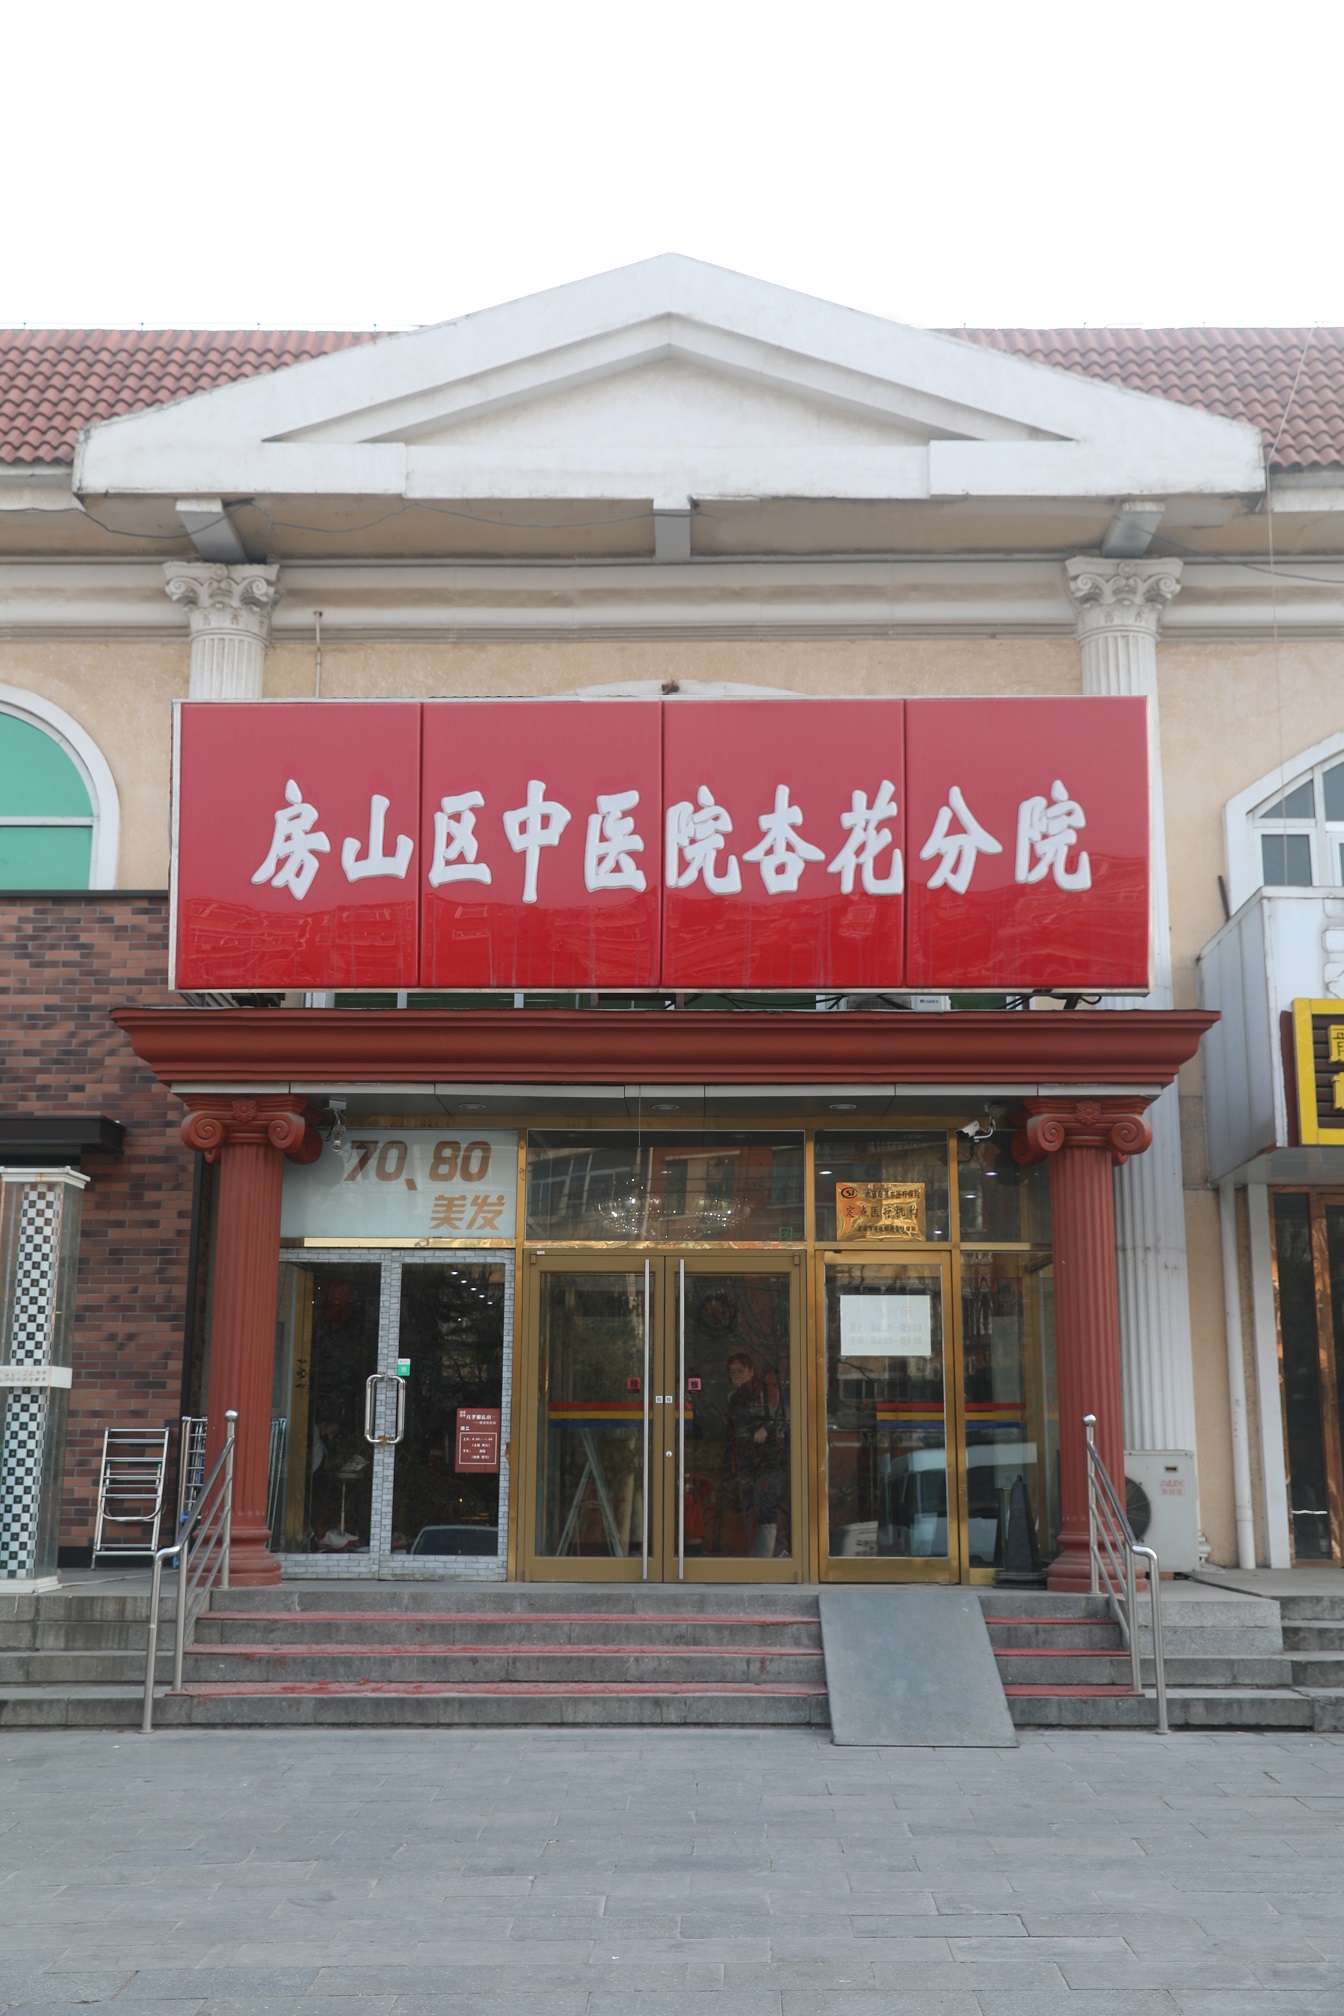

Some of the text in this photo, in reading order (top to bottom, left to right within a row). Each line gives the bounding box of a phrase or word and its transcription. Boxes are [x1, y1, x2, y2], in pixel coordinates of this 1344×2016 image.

[252, 779, 1093, 904] 房山区中医院杏花分院
[428, 1194, 506, 1231] 美发
[846, 1205, 919, 1219] 定点医疗机构
